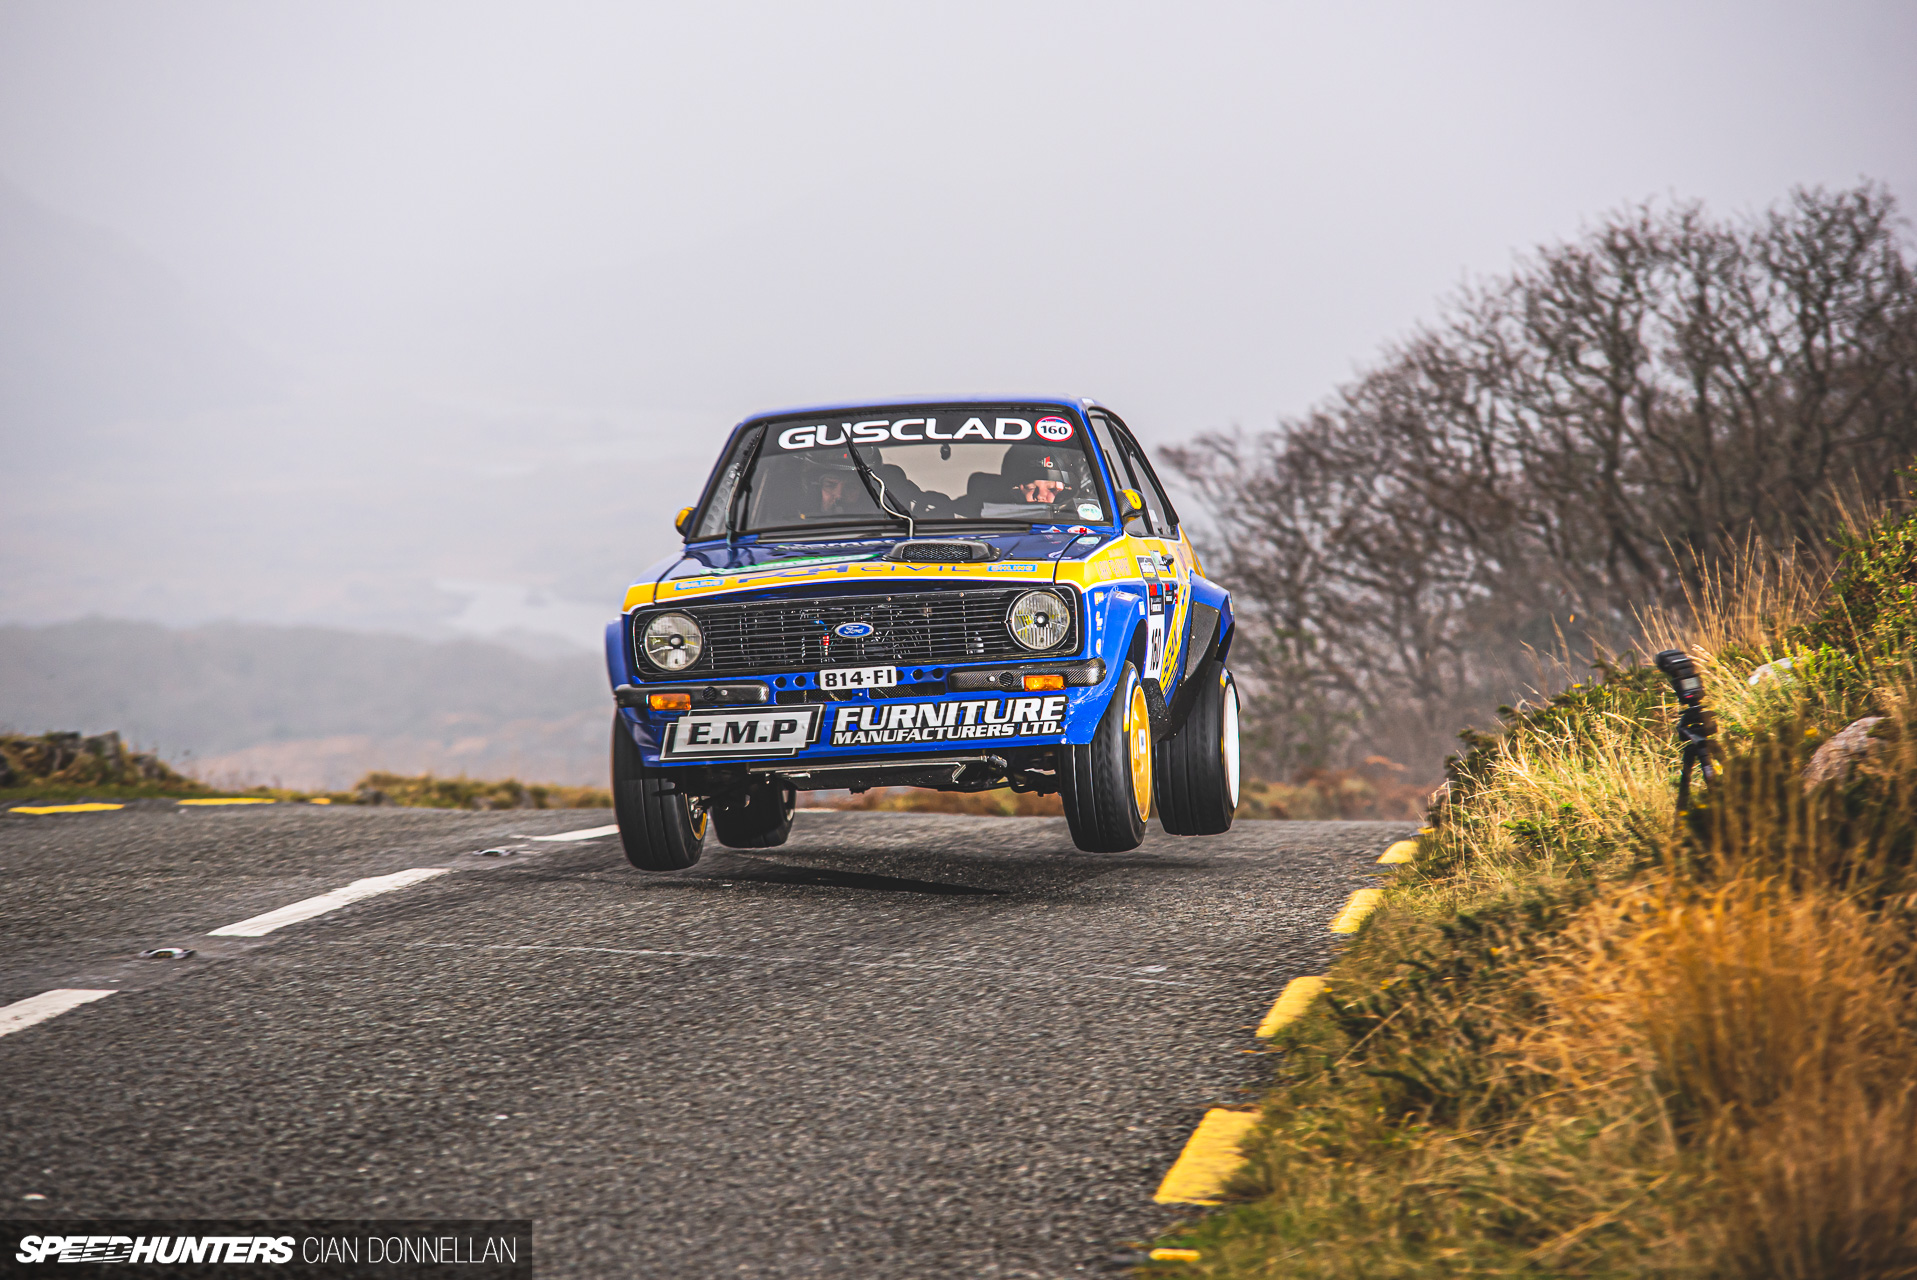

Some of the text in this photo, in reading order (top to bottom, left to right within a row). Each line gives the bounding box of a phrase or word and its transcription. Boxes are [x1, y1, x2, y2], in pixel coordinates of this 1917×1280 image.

[778, 417, 1032, 450] GUSCLAD
[1040, 425, 1068, 435] 160
[861, 564, 970, 572] CIVIL
[824, 669, 892, 687] 814-FI
[834, 695, 1067, 732] FURNITURE
[687, 718, 799, 746] E.M.P
[832, 718, 1062, 746] MANUFACTURERS LTD.
